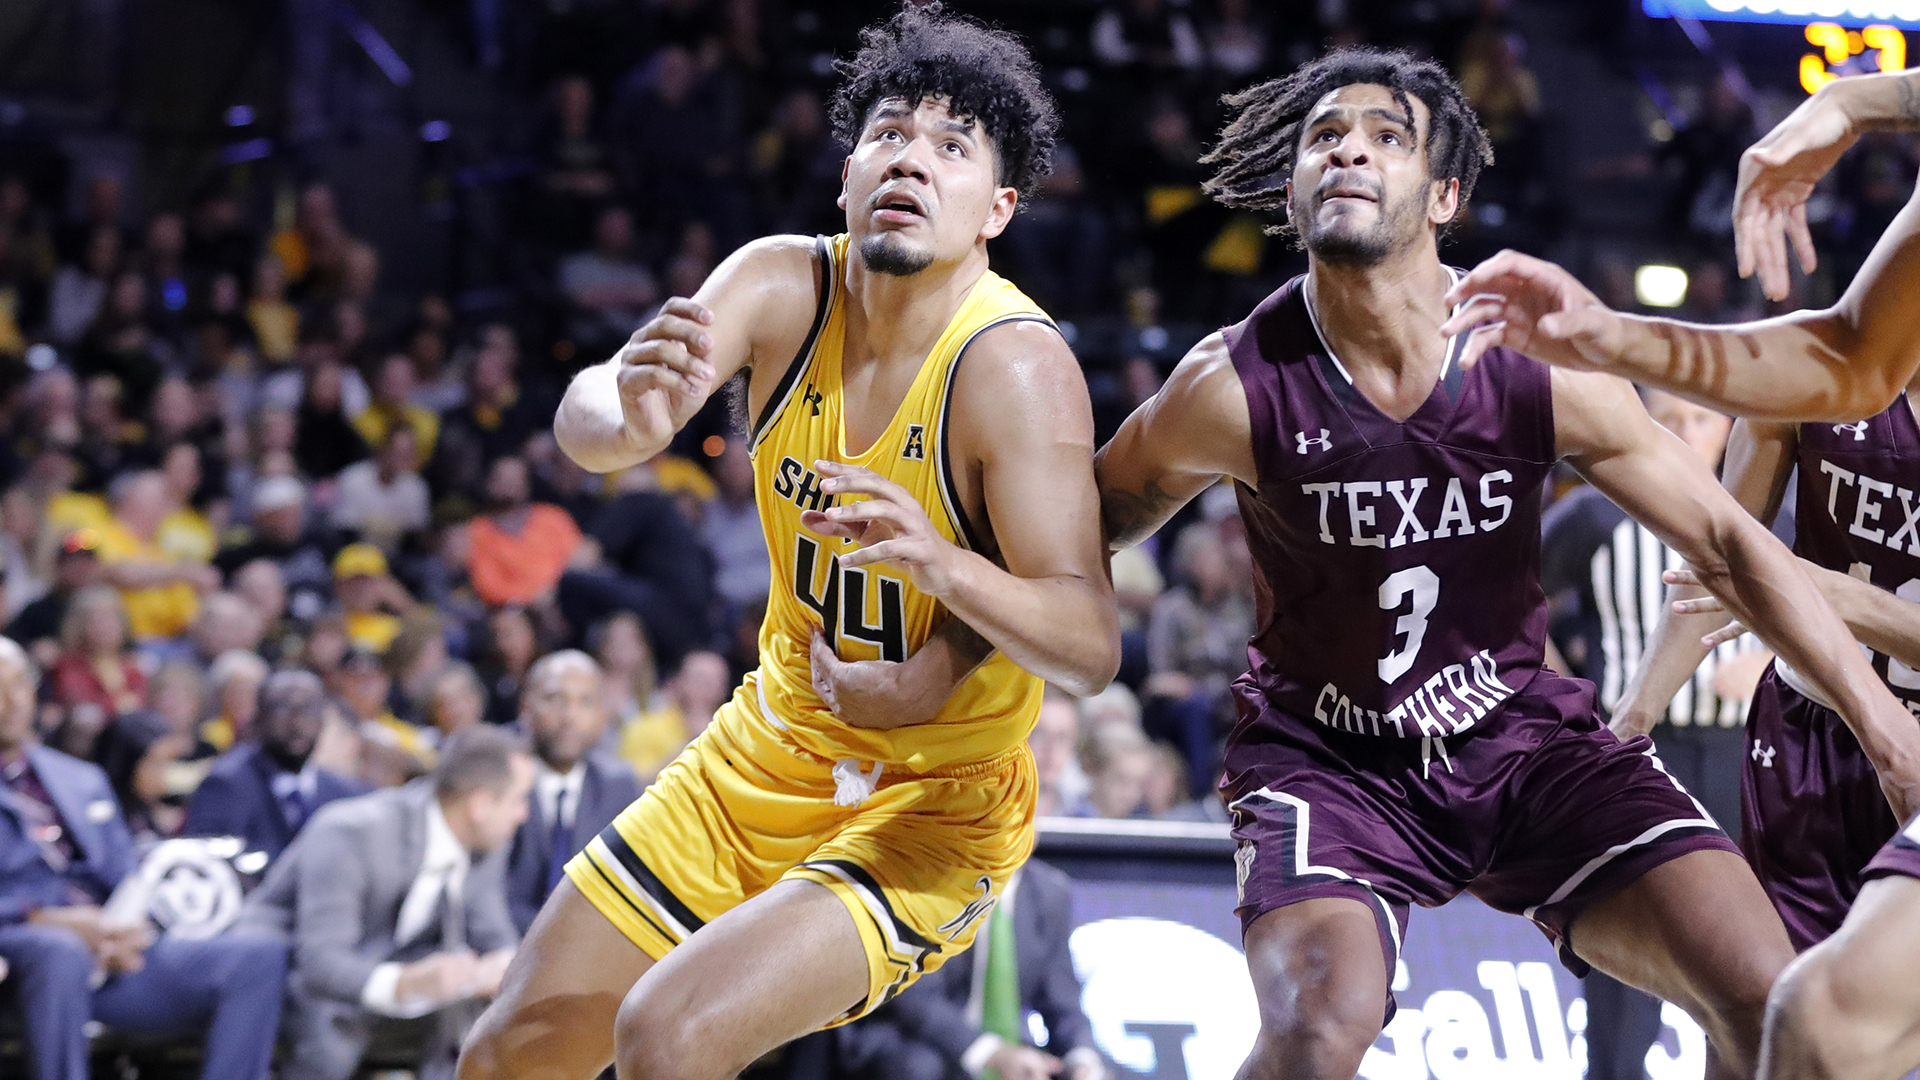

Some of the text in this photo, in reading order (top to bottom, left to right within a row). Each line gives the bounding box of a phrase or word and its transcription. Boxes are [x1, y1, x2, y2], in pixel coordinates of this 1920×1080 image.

[1301, 469, 1513, 549] TEXAS
[793, 531, 908, 663] 44
[1377, 564, 1440, 685] 3
